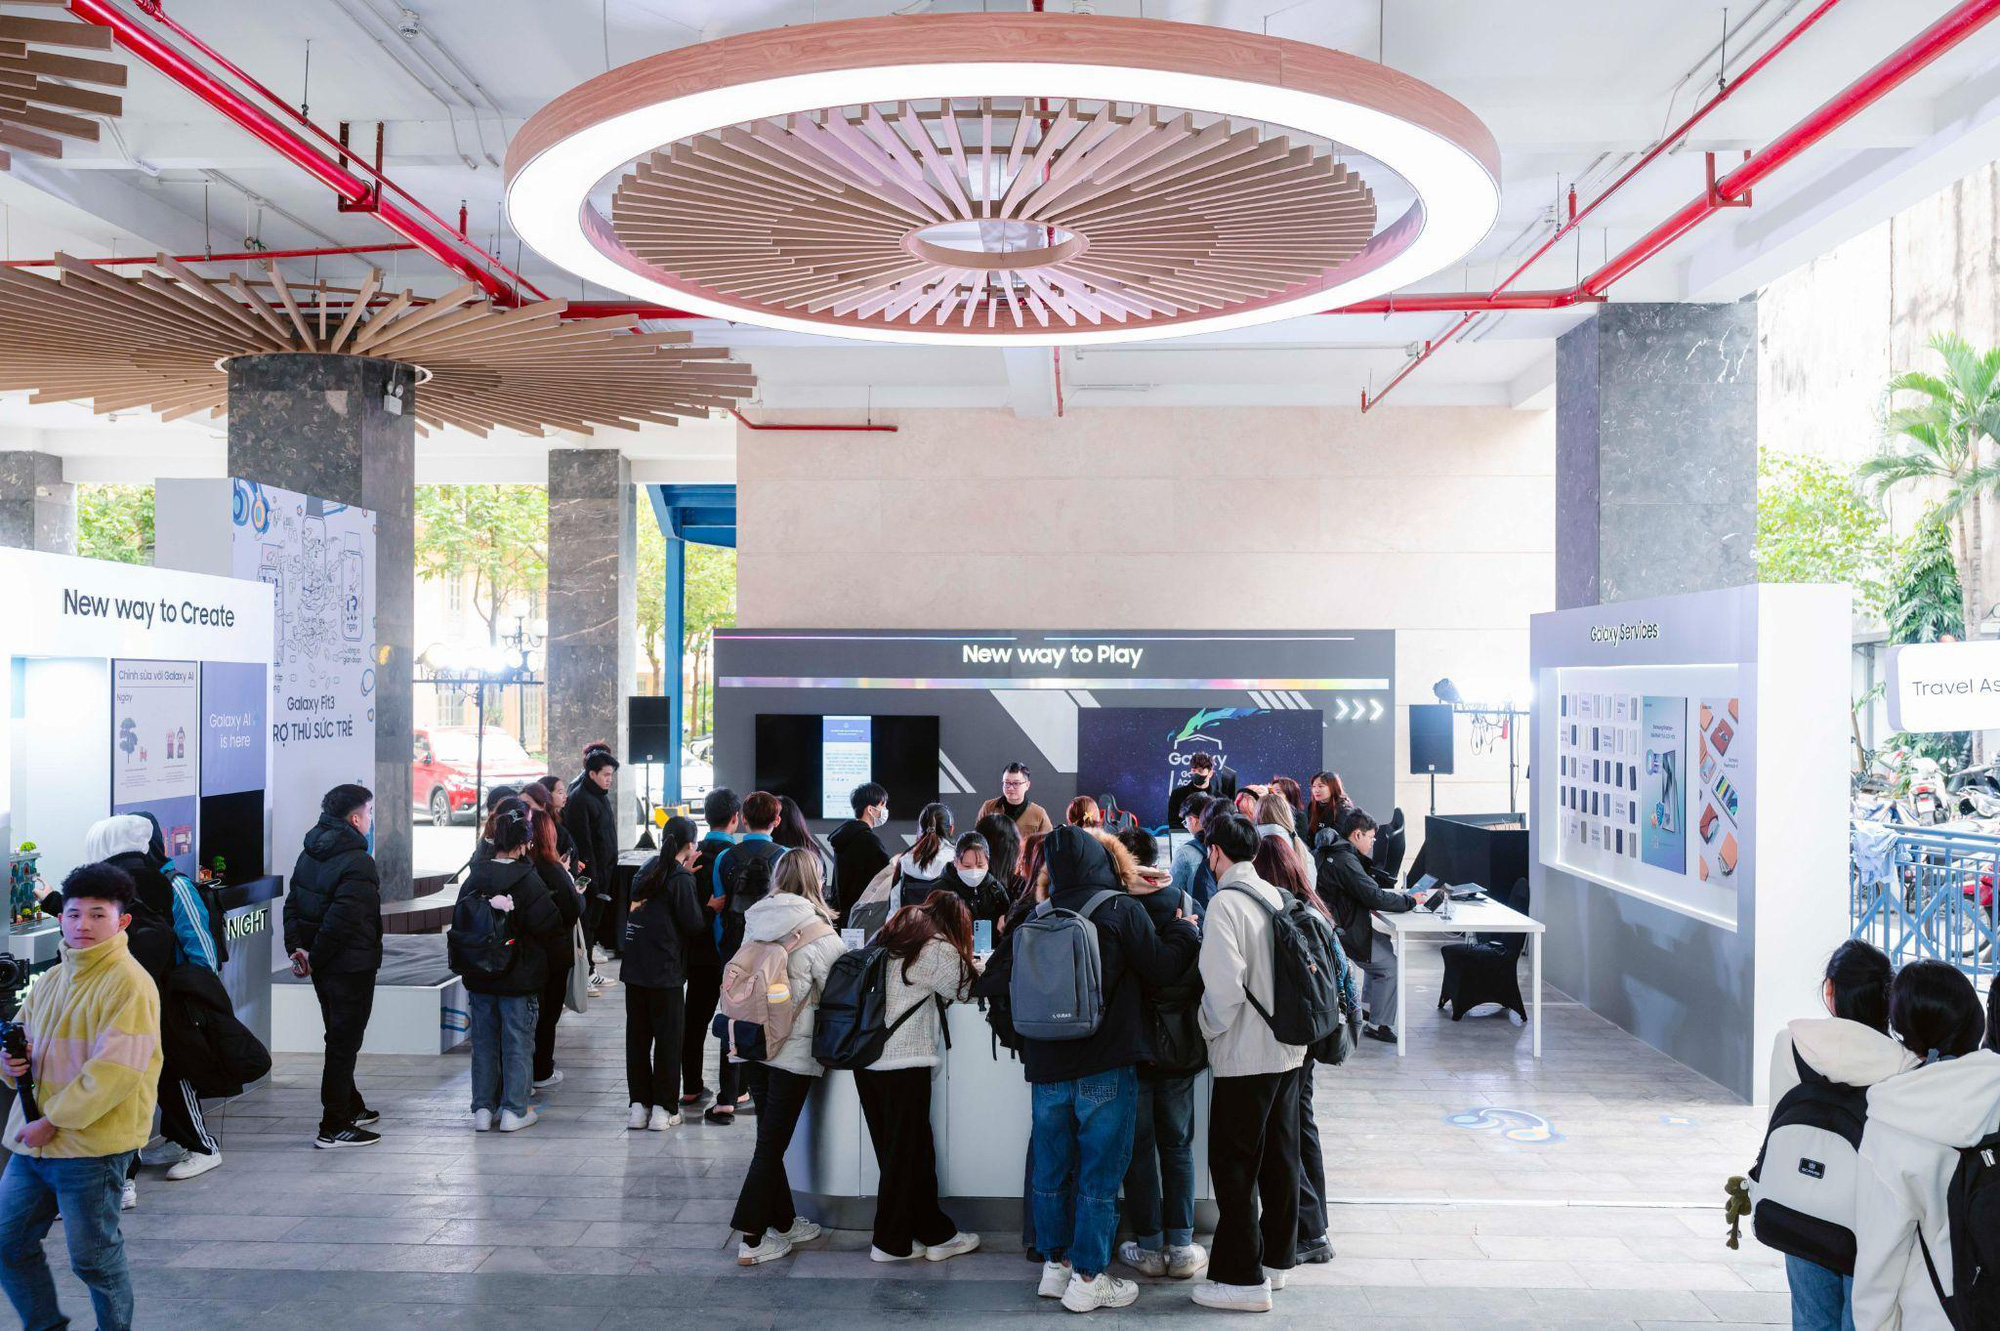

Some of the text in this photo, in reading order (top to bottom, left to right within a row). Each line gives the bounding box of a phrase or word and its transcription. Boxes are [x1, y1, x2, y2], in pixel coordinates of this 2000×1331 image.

[64, 588, 235, 630] New way to Create
[1591, 619, 1659, 647] Galaxy Services
[962, 645, 1144, 669] New way to Play
[164, 671, 187, 684] Galaxy
[188, 671, 195, 681] AI
[1912, 678, 1974, 696] Travel
[287, 694, 336, 715] Galaxy Fit3
[209, 713, 251, 731] Galaxy AI
[273, 714, 354, 748] RỢ THỦ SỨC TRẺ
[220, 733, 251, 749] is here
[227, 908, 269, 941] NIGHT
